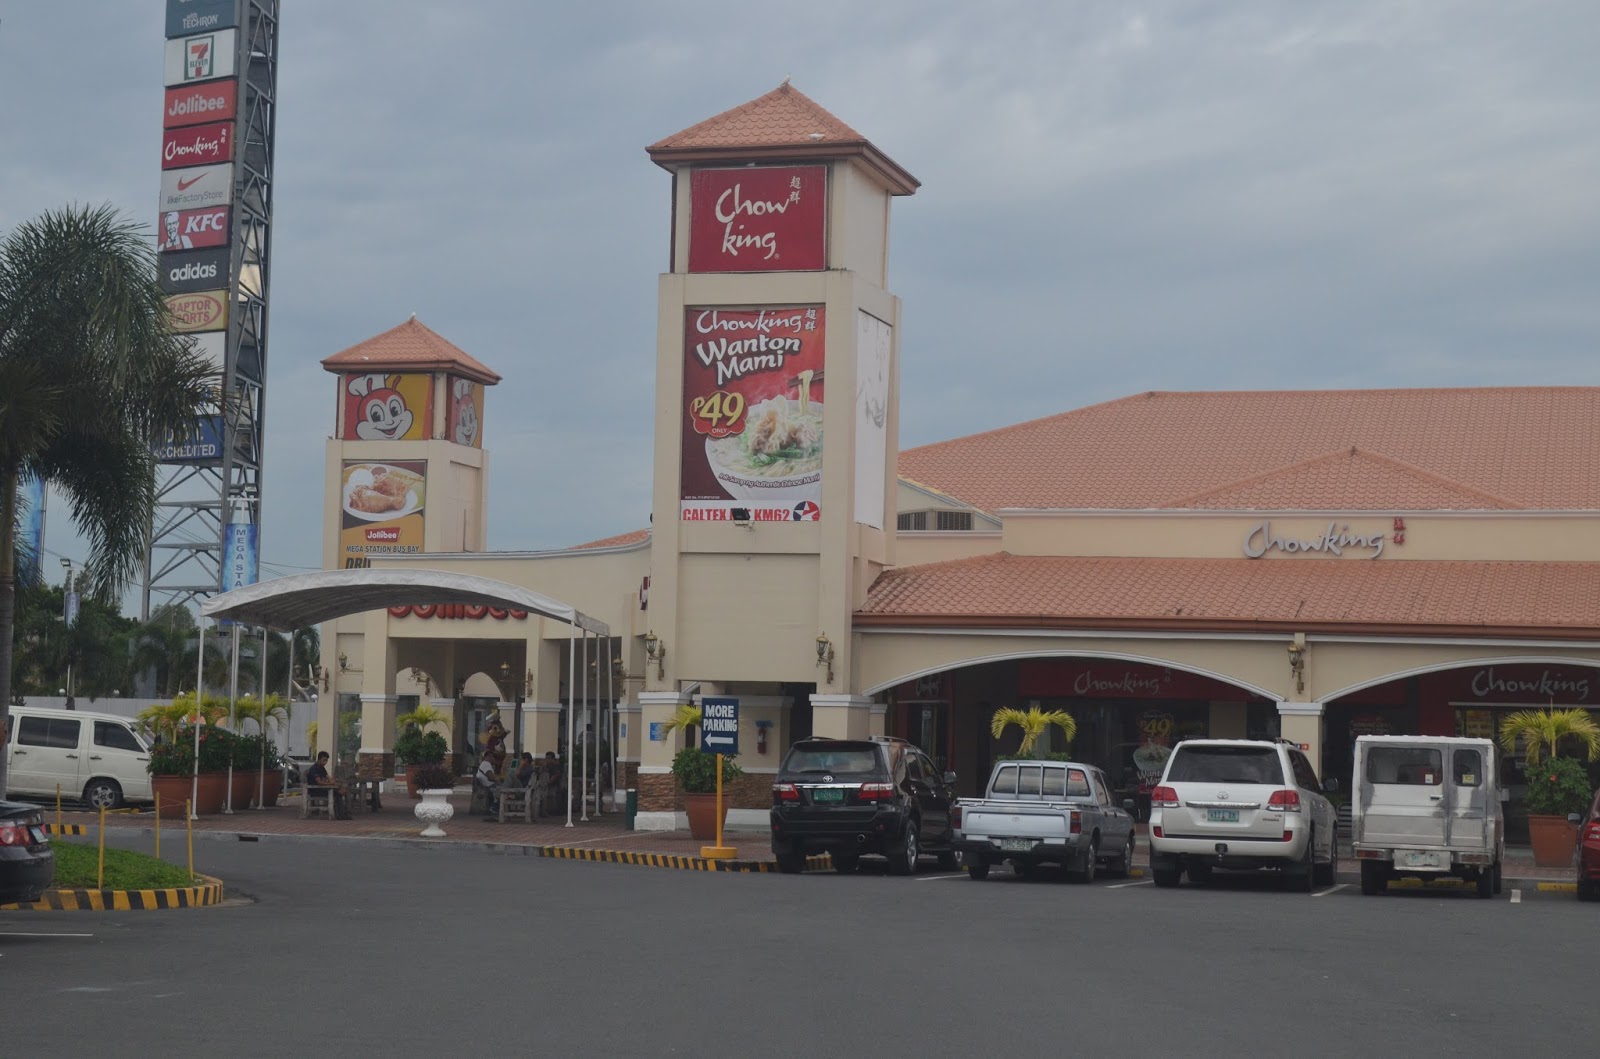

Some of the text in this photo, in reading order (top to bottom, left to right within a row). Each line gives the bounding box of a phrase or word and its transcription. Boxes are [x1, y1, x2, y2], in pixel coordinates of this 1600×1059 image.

[182, 15, 218, 29] TECHRON
[169, 95, 225, 116] Jollibee
[165, 136, 219, 160] Chowking
[715, 183, 789, 223] Chow
[185, 212, 225, 233] KFC
[722, 221, 776, 259] king
[170, 262, 217, 281] adidas
[696, 310, 802, 333] Chowking
[696, 335, 800, 366] Wanton
[717, 350, 783, 385] Mami
[683, 508, 727, 521] CALTEX
[754, 508, 790, 521] KM62
[235, 528, 246, 560] MEGA
[367, 530, 398, 539] Jollibee
[1242, 519, 1385, 560] Chowking
[346, 545, 420, 553] MEGA STATION BUS BAY
[1074, 670, 1160, 696] Chowking
[1471, 668, 1589, 701] Chowking
[705, 704, 735, 717] MORE
[703, 718, 738, 732] PARKING
